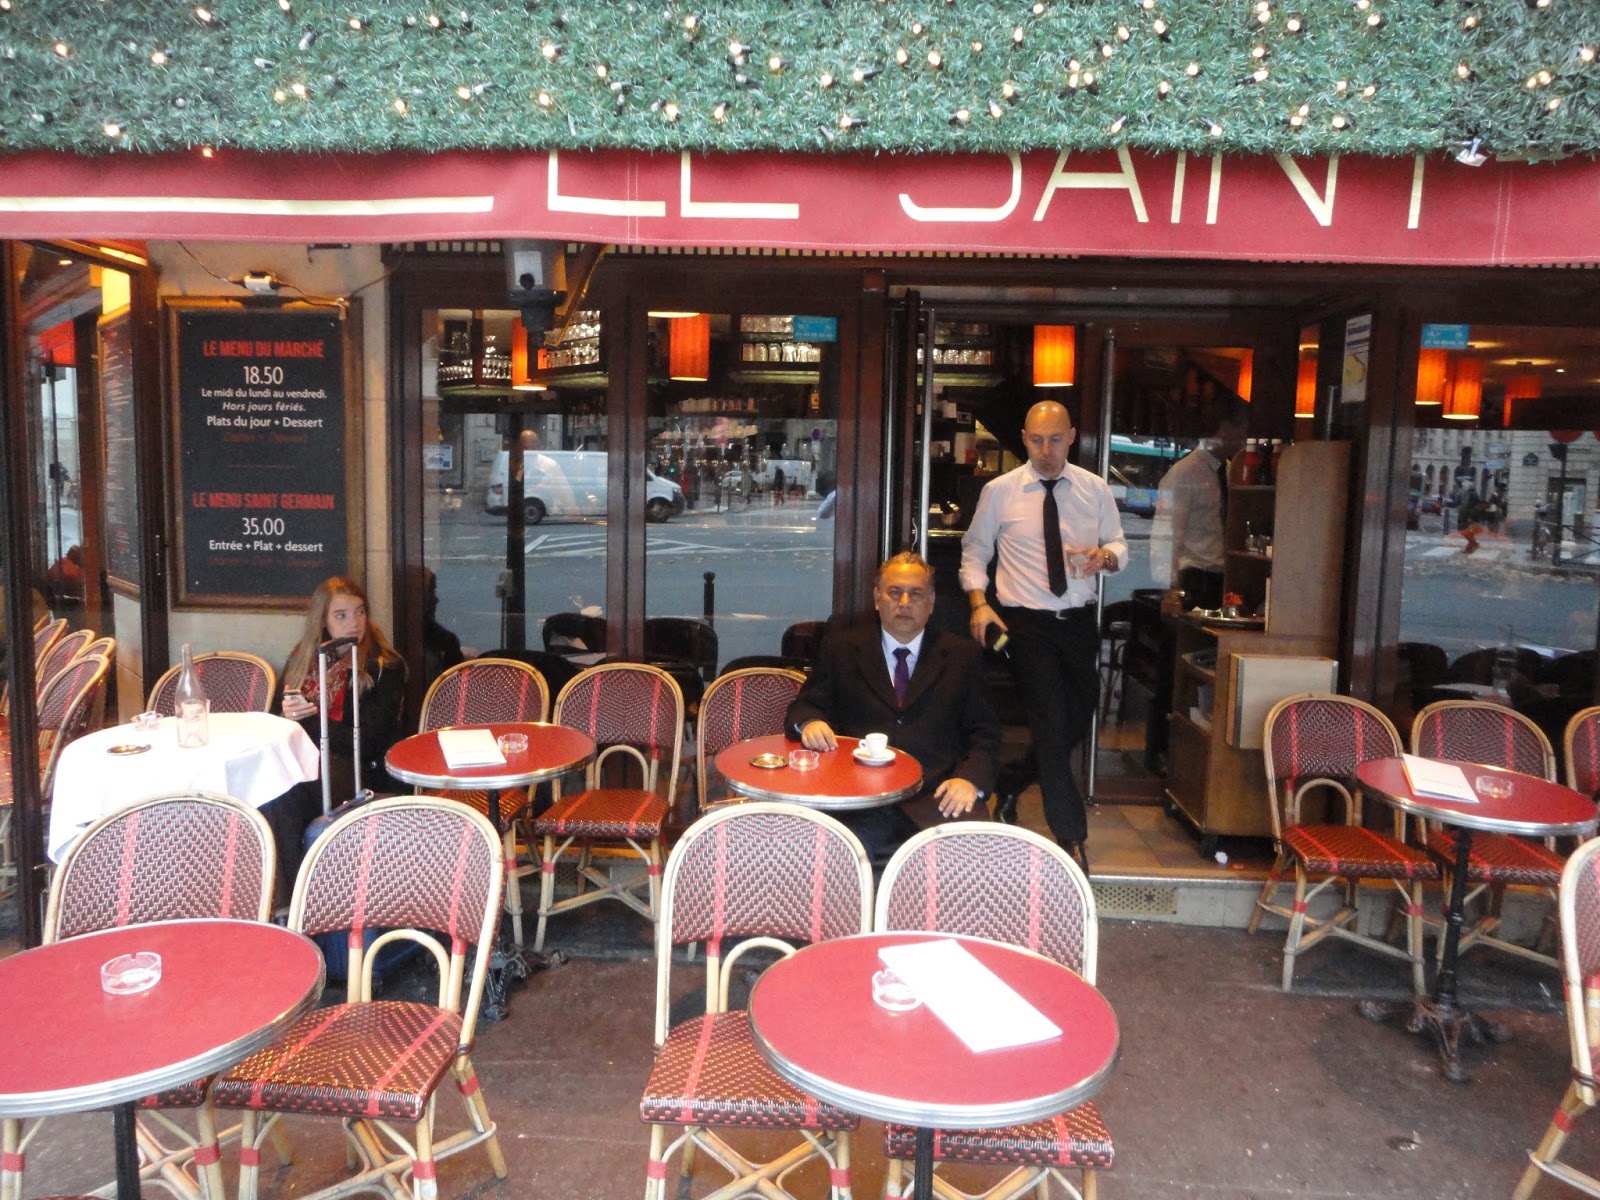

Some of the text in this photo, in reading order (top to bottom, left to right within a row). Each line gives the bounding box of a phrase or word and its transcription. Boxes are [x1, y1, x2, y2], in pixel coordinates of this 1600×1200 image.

[202, 341, 217, 357] LE
[220, 341, 253, 357] MENU
[255, 341, 272, 357] DU
[243, 366, 284, 385] 18.50
[201, 388, 213, 398] Le
[214, 388, 233, 398] midi
[235, 388, 247, 398] du
[249, 388, 271, 399] lundi
[273, 390, 285, 399] au
[222, 401, 246, 412] Hors
[247, 402, 273, 413] jours
[207, 415, 232, 427] Plats
[234, 415, 248, 427] du
[249, 416, 271, 430] jour
[282, 416, 323, 429] Dessert
[192, 492, 335, 510] LE MENU SAINT GERMAIN
[242, 517, 286, 536] 35.00
[208, 539, 243, 551] Entrée
[253, 540, 273, 552] Plat
[284, 540, 324, 553] dessert
